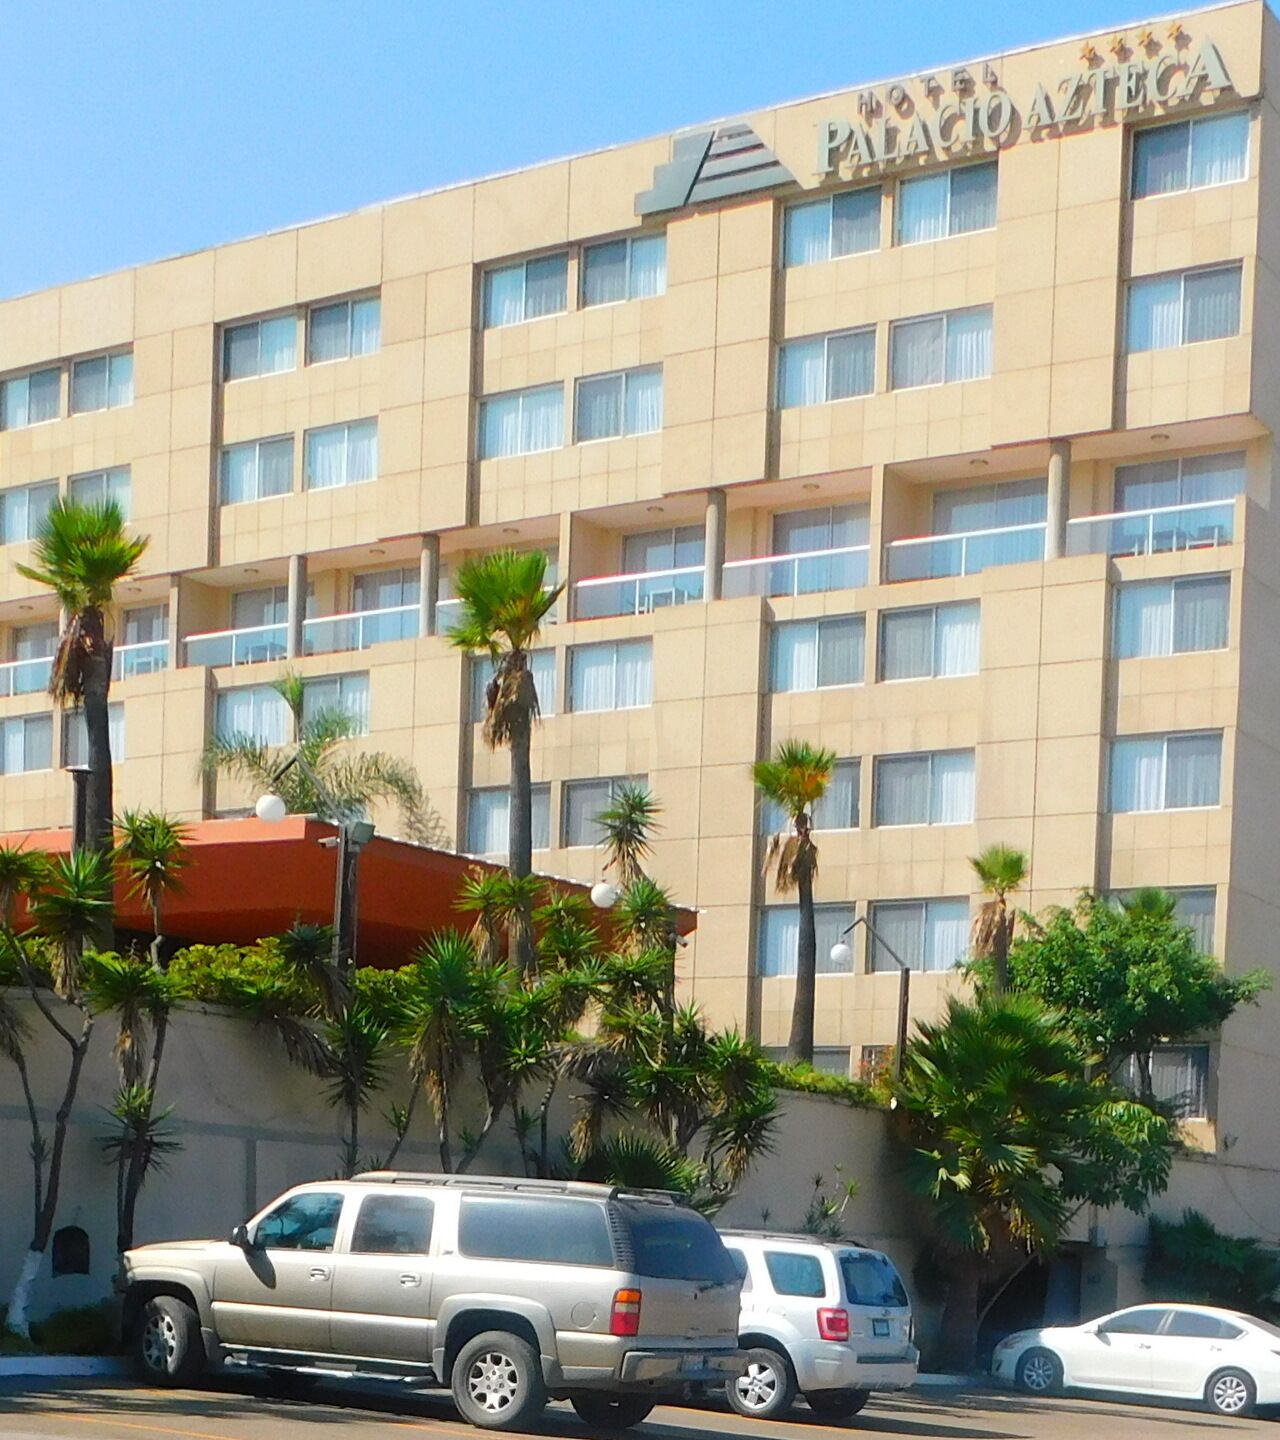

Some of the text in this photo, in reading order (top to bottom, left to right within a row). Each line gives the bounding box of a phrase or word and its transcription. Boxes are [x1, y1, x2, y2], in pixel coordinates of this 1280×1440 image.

[814, 34, 1232, 175] PALACIO AZTECA
[857, 62, 996, 114] HOTEL
